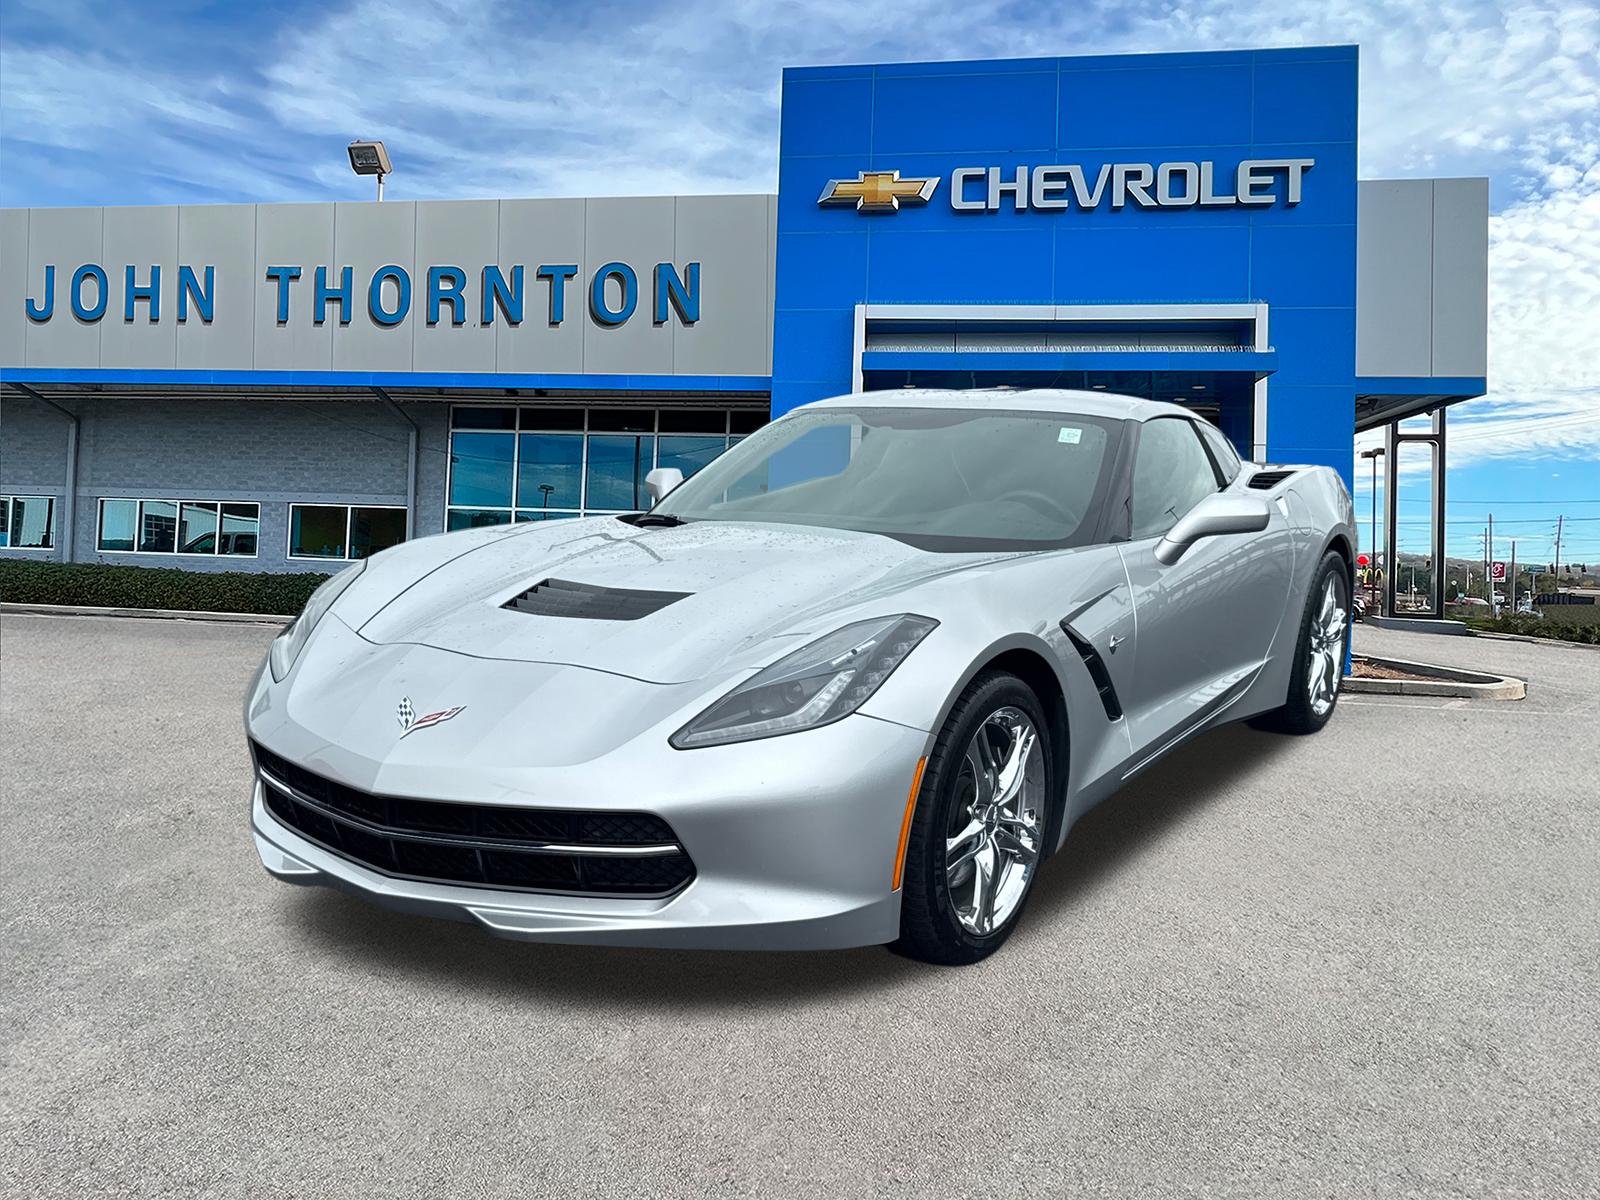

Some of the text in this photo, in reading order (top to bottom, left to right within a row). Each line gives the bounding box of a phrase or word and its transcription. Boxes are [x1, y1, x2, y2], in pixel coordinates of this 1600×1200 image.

[950, 157, 1316, 213] CHEVROLET
[26, 261, 702, 327] JOHN THORNTON
